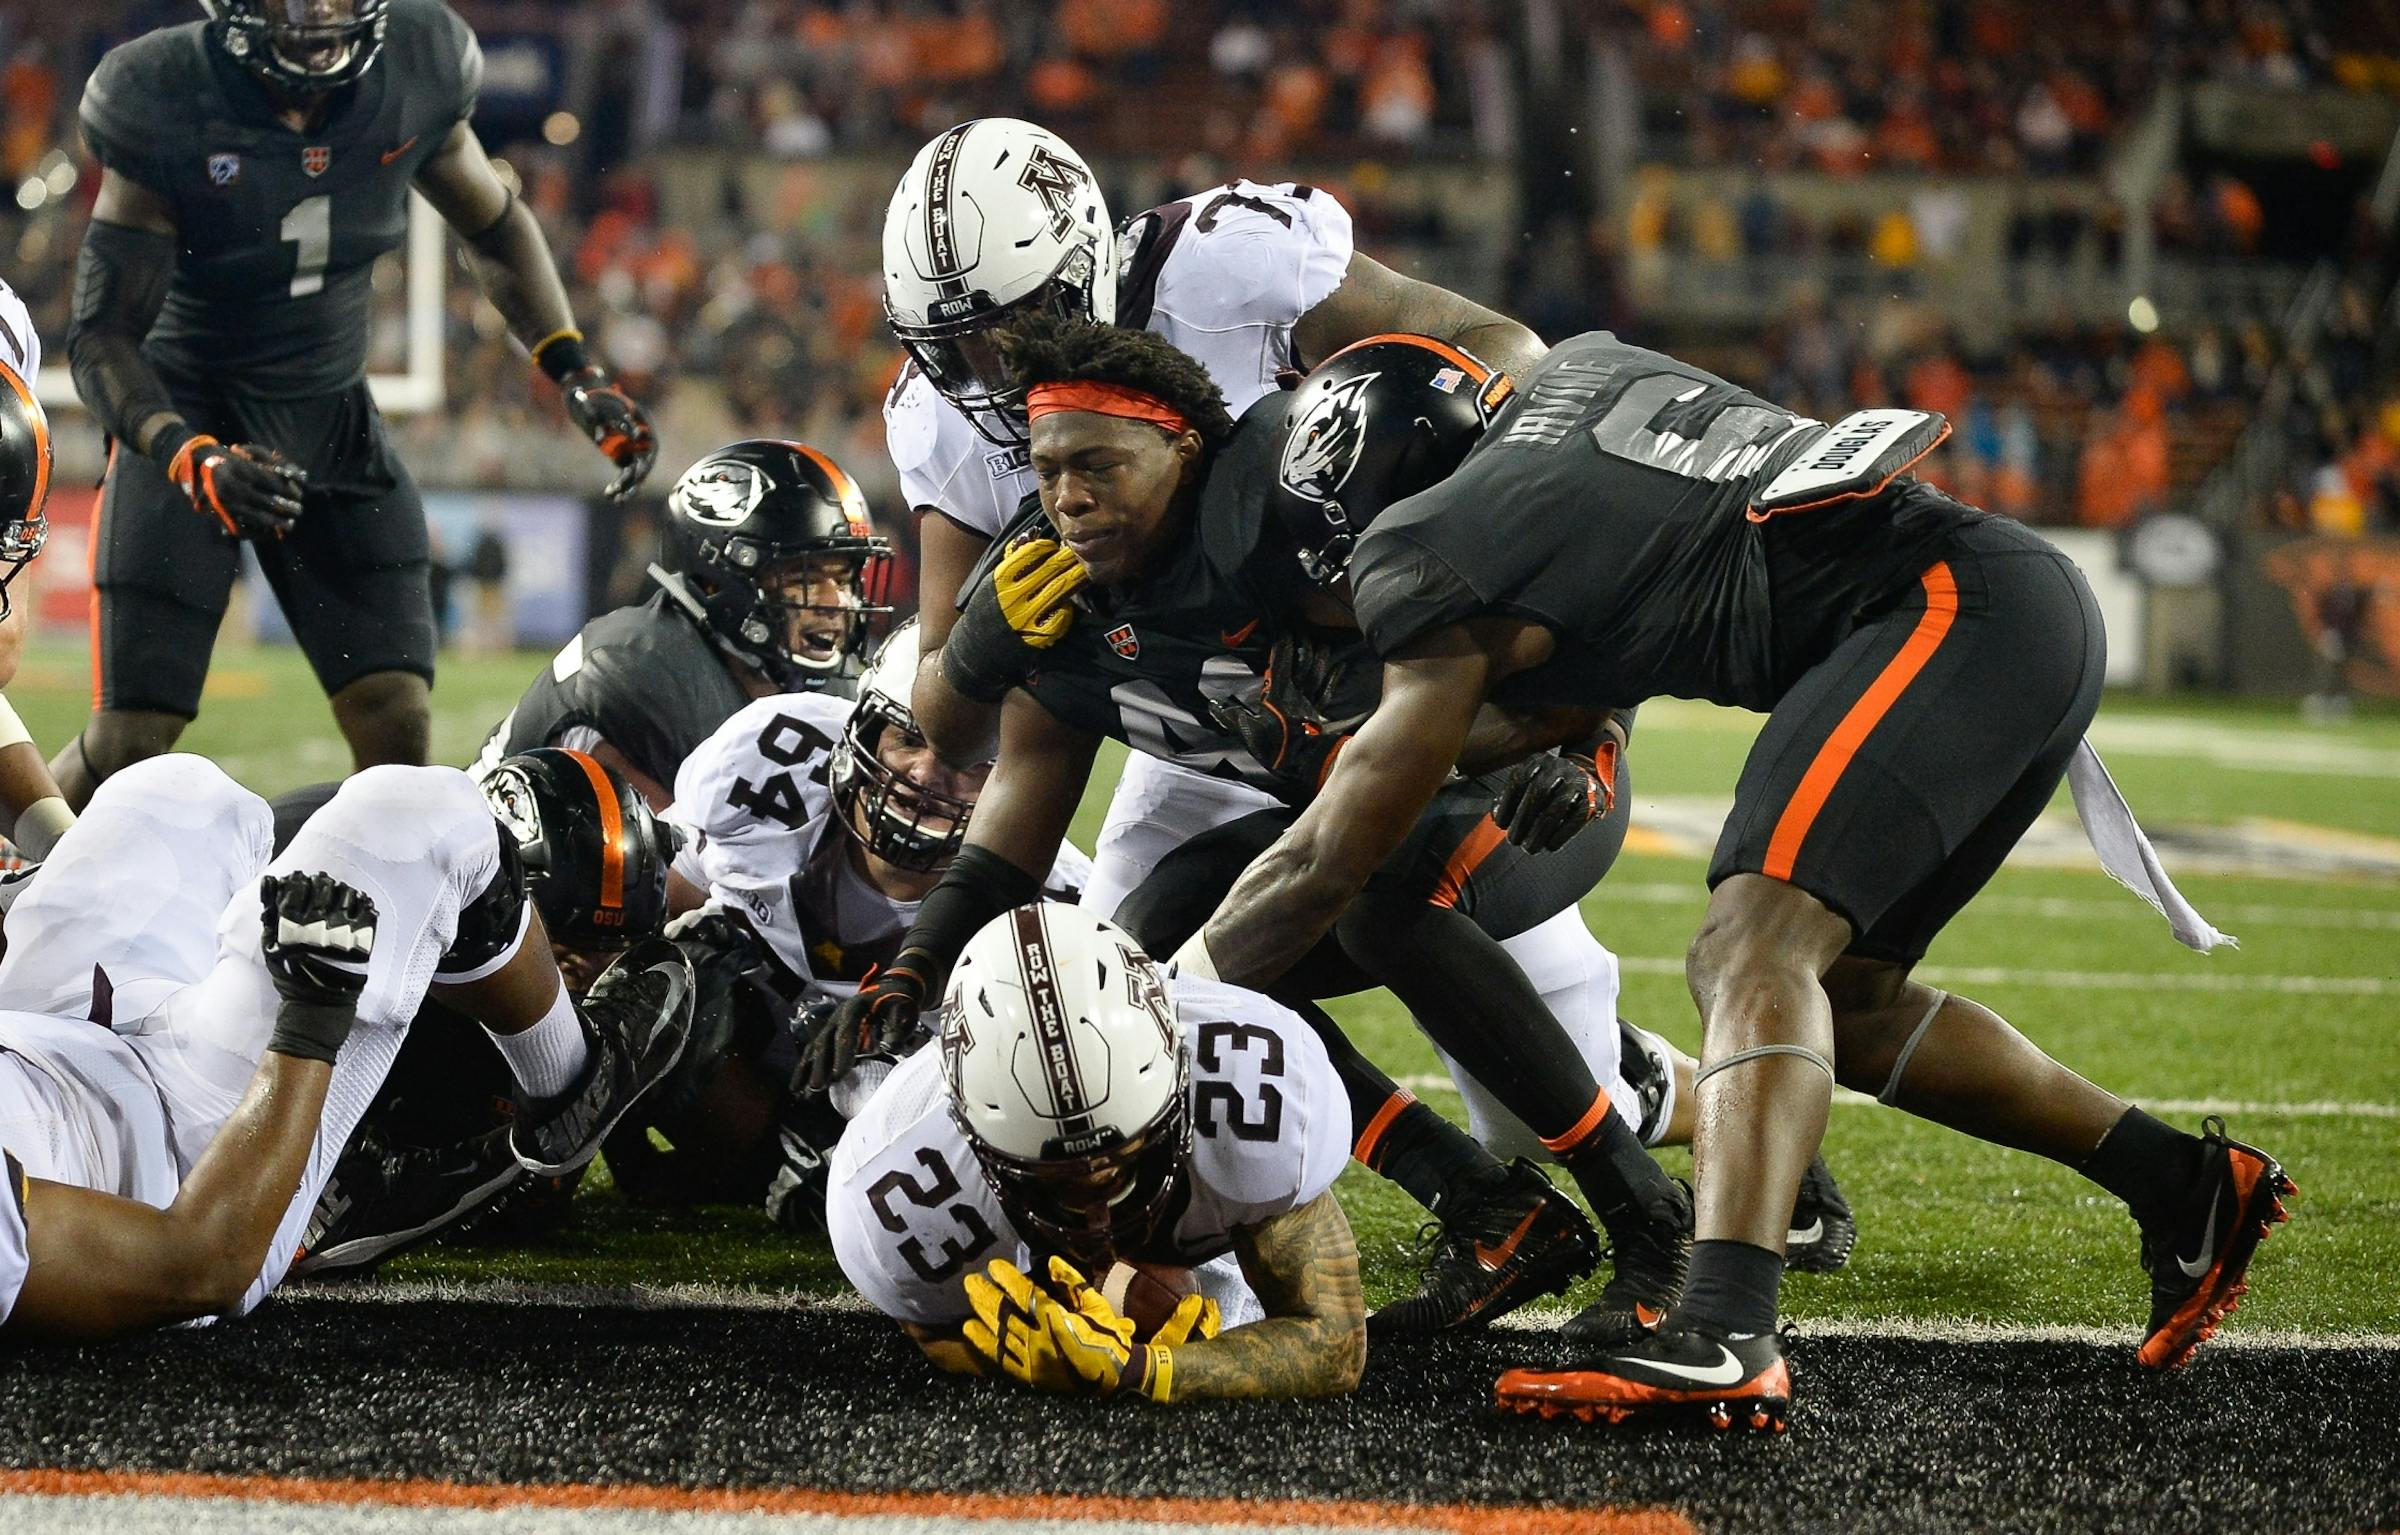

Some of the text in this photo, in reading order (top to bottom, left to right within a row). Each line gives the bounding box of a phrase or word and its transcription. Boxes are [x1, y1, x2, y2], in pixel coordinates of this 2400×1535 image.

[932, 133, 959, 268] ROW THE BOAT
[1016, 144, 1092, 244] M
[280, 195, 331, 298] 1
[939, 297, 974, 318] ROW
[1501, 359, 1620, 446] IRVINE
[1808, 420, 1894, 470] DOUGLAS
[849, 523, 870, 536] OSU
[726, 713, 835, 831] 64
[593, 909, 625, 926] OSU
[1026, 943, 1075, 1110] ROW THE BOAT
[1194, 1021, 1284, 1142] 23
[1063, 1132, 1101, 1153] ROW
[865, 1146, 998, 1284] 23
